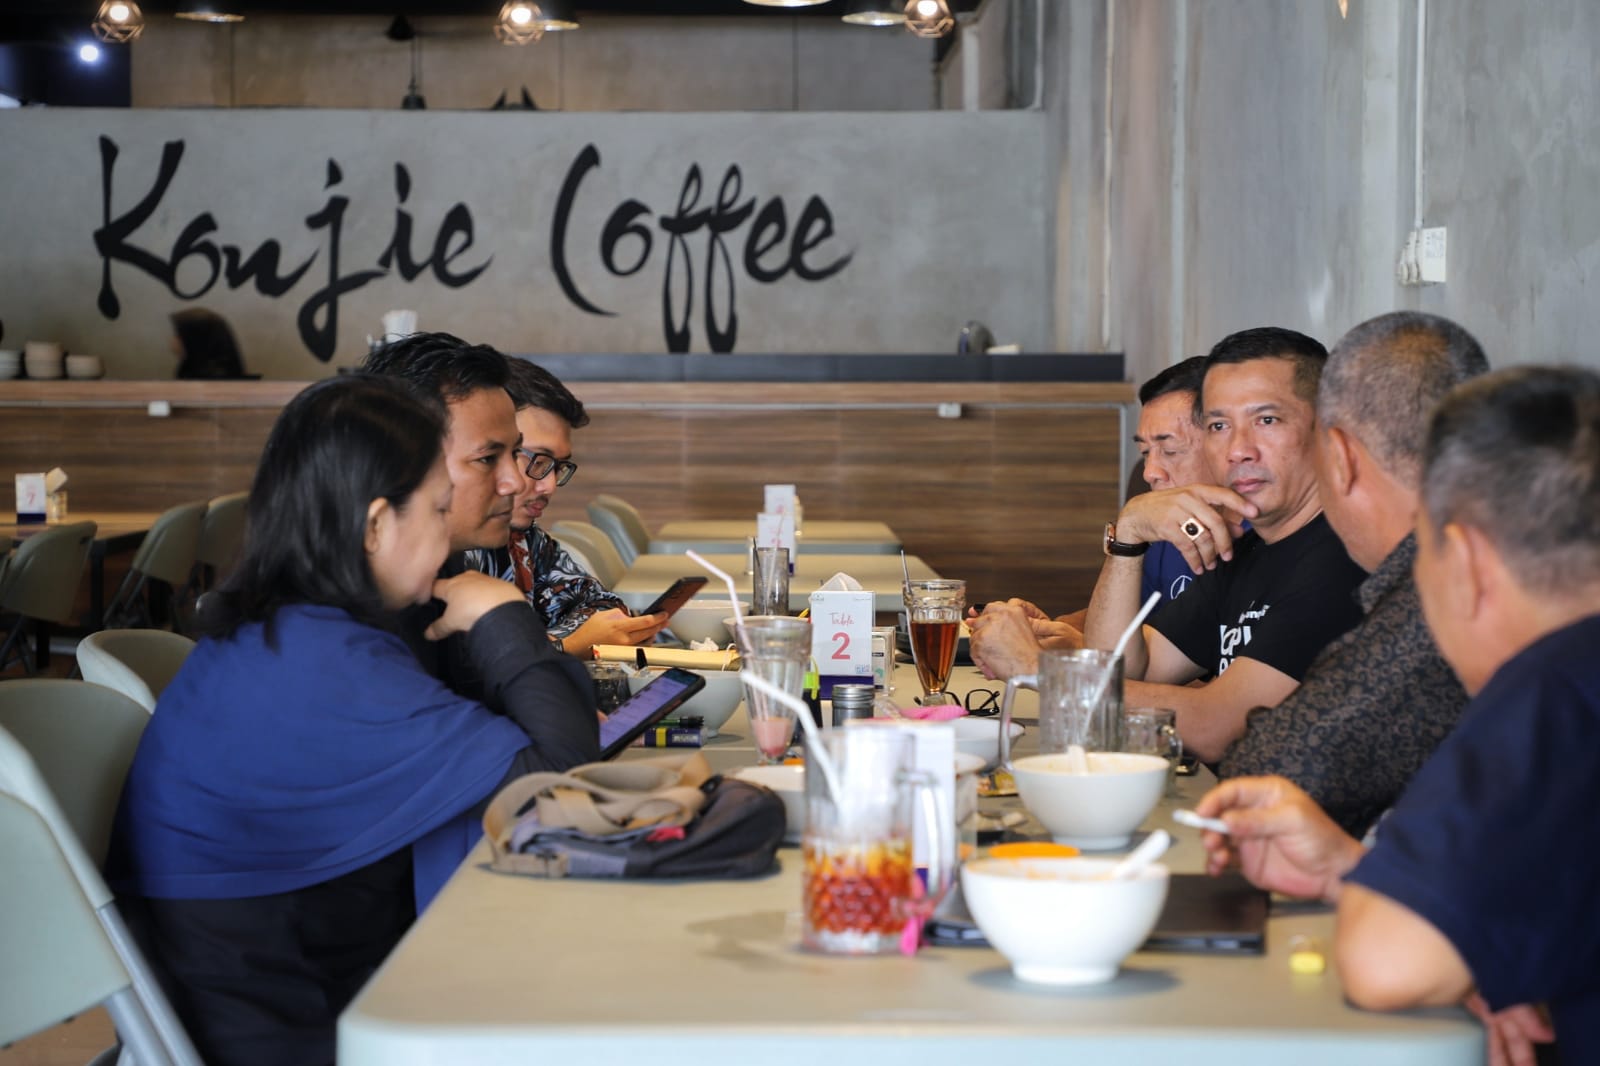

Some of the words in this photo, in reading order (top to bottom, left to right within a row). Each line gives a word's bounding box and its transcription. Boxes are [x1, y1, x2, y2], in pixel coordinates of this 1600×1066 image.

[551, 142, 855, 354] Coffee
[829, 612, 855, 626] Table
[831, 631, 851, 660] 2
